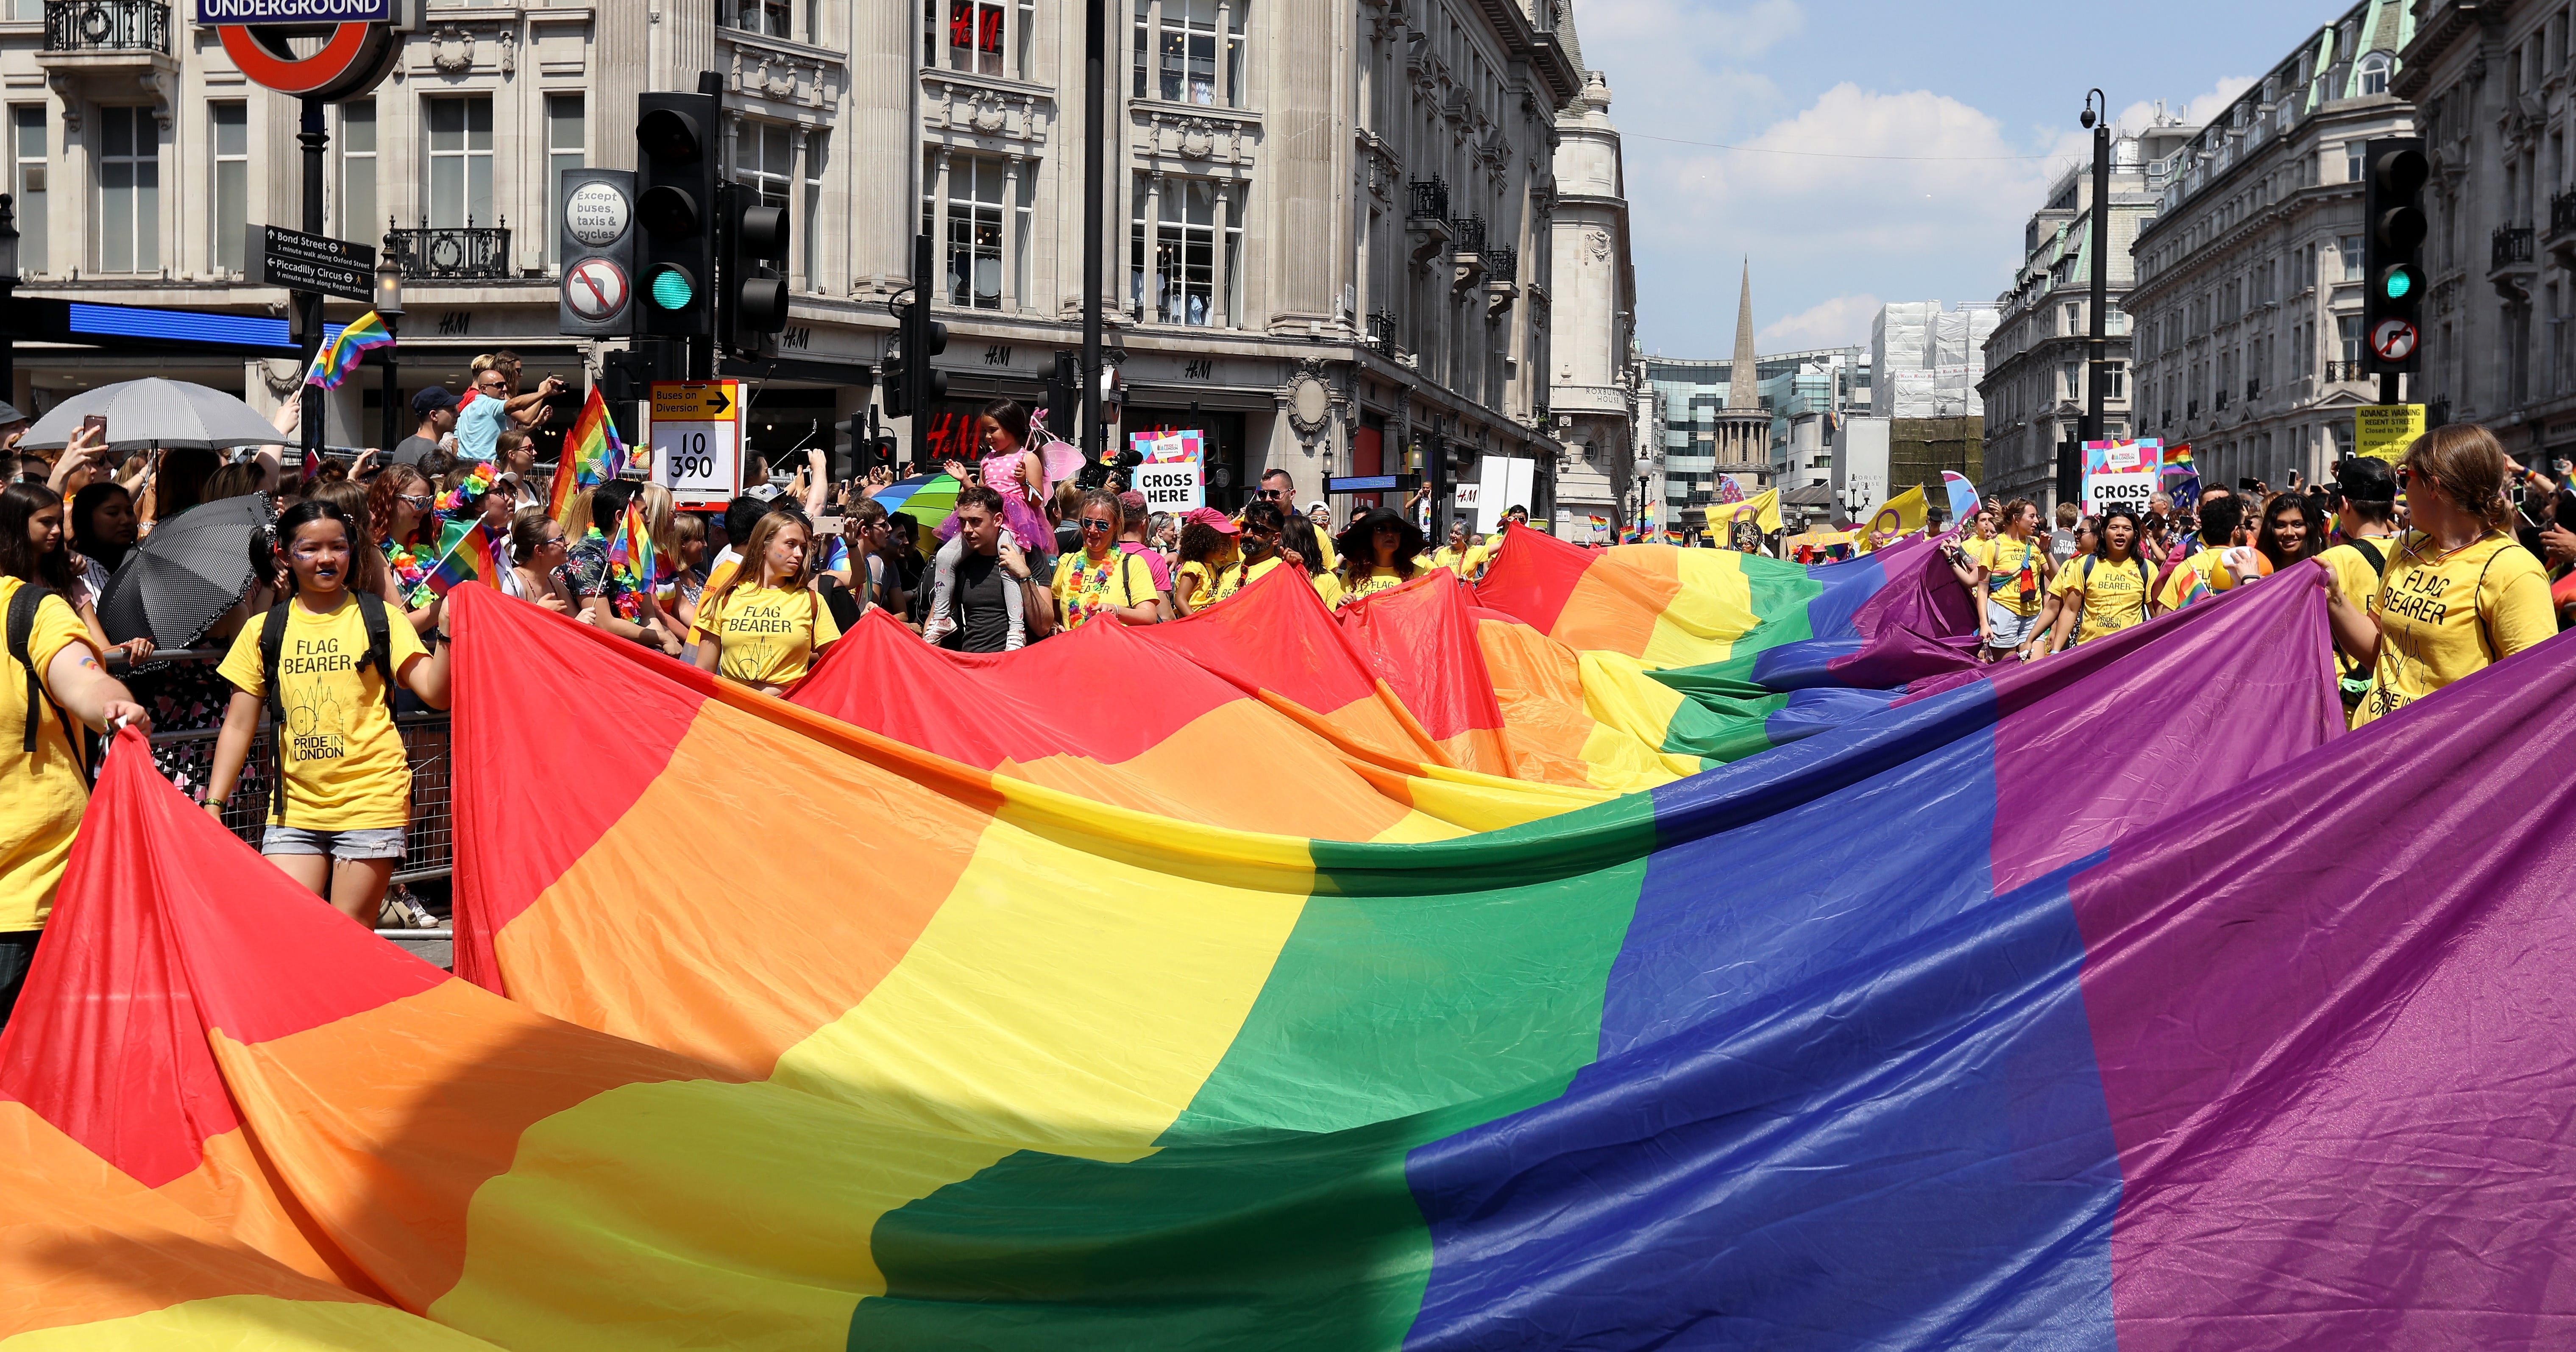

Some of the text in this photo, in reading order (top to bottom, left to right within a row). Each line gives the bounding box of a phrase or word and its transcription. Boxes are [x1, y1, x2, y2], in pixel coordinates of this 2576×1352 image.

[204, 0, 381, 17] UNDERGROUND
[950, 5, 1000, 52] H&M
[577, 191, 617, 202] Except
[577, 203, 614, 214] buses,
[577, 215, 616, 226] taxis &
[278, 232, 327, 250] Bond Street
[577, 229, 615, 242] cycles
[282, 246, 302, 255] minute
[304, 250, 316, 258] walk
[317, 253, 331, 262] along
[333, 256, 352, 266] Oxford
[354, 260, 370, 269] Street
[277, 259, 342, 281] Piccadilly Circus
[282, 273, 301, 282] minute
[303, 276, 315, 285] walk
[317, 279, 331, 289] along
[333, 282, 351, 292] Regent
[353, 287, 369, 295] Street
[439, 312, 471, 335] H&M
[783, 326, 810, 350] H&M
[985, 345, 1012, 367] H&M
[1185, 360, 1212, 380] H&M
[656, 391, 682, 400] Buses
[1586, 388, 1623, 397] ROXBURG
[1597, 395, 1619, 403] HOUSE
[656, 403, 699, 412] Diversion
[2360, 409, 2389, 417] ADVANCE
[682, 432, 706, 454] 10
[927, 412, 982, 461] H&M
[671, 456, 713, 478] 390
[1142, 473, 1192, 487] CROSS
[1147, 489, 1189, 503] HERE
[1457, 489, 1477, 503] H&M
[2094, 484, 2150, 498] CROSS
[2100, 501, 2145, 515] HRE
[2054, 546, 2077, 555] MANAG
[2059, 539, 2076, 548] STAG
[2105, 573, 2125, 581] FLAG
[2403, 570, 2450, 598] FLAG
[2098, 581, 2130, 590] BEARER
[744, 606, 780, 618] FLAG
[2384, 586, 2446, 625] BEARER
[729, 618, 791, 633] BEARER
[297, 638, 338, 655] FLAG
[285, 655, 351, 674] BEARER
[294, 735, 343, 749] PRIDE IN
[294, 746, 344, 761] LONDON
